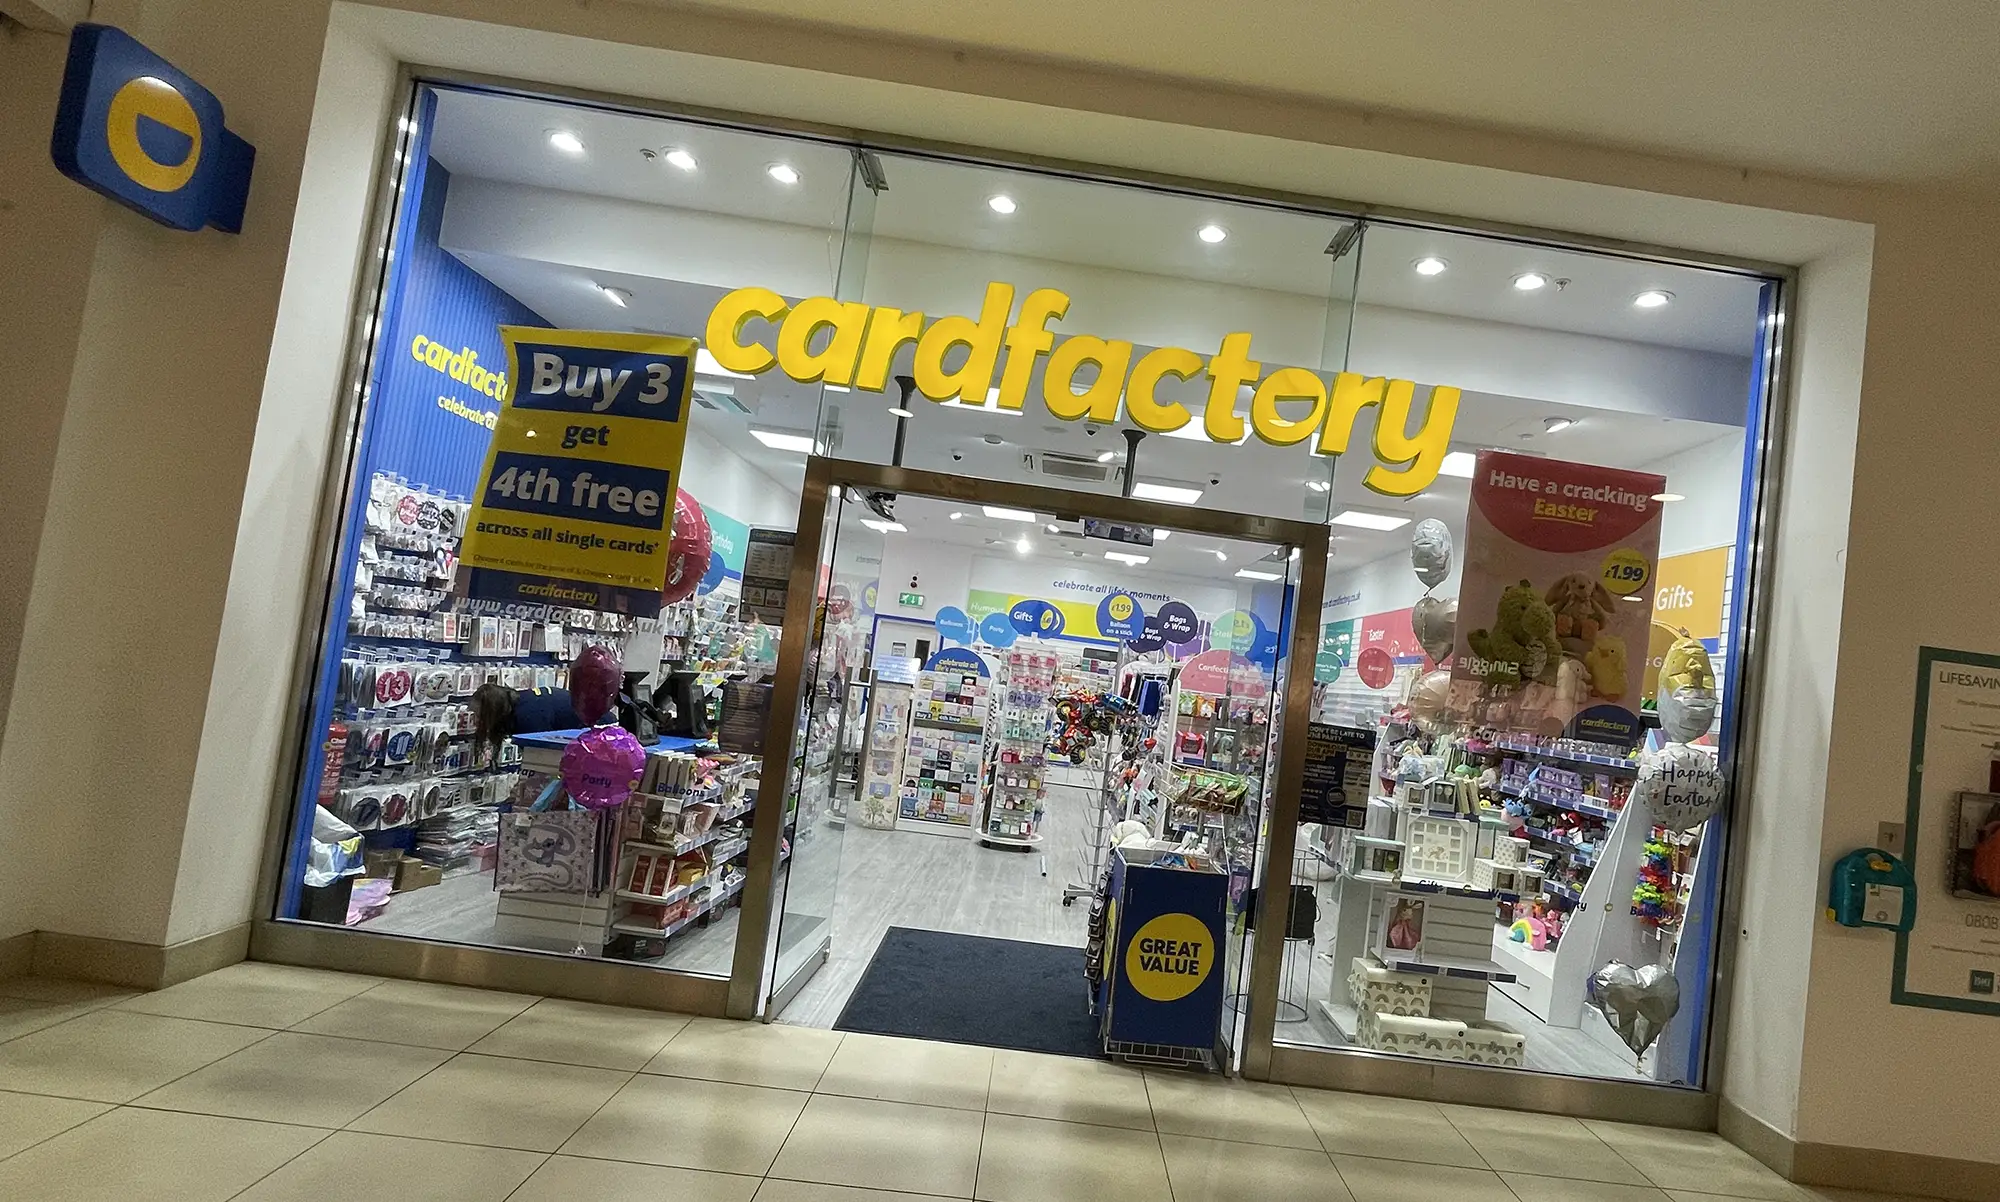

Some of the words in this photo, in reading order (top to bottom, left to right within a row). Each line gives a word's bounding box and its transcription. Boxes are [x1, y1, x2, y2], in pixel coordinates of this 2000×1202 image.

[412, 334, 509, 402] cardfact
[530, 352, 632, 412] Buy
[638, 363, 673, 404] 3
[705, 282, 1461, 496] cardfactory
[438, 396, 485, 426] celebrate
[561, 424, 610, 449] get
[491, 466, 559, 504] 4th
[572, 471, 661, 517] free
[1489, 469, 1541, 494] Have
[1547, 481, 1559, 495] a
[1563, 483, 1649, 512] cracking
[1533, 498, 1599, 523] Easter
[476, 521, 529, 539] across
[532, 526, 553, 542] all
[556, 530, 605, 551] single
[1604, 563, 1644, 582] £1.99
[518, 582, 599, 606] cardfactory
[1053, 579, 1095, 593] celebrate
[1095, 582, 1107, 594] all
[1129, 590, 1171, 602] moments
[1656, 584, 1694, 611] Gifts
[1013, 611, 1034, 623] Gifts
[1109, 621, 1131, 630] Balloon
[1169, 615, 1188, 625] Bags
[1171, 622, 1191, 634] Wrap
[1144, 627, 1160, 636] Bags
[1146, 632, 1163, 642] Wrap
[1581, 718, 1631, 733] cardfactory
[581, 773, 612, 789] Party
[1662, 760, 1715, 787] Happy
[656, 782, 705, 798] Balloons
[1140, 938, 1202, 958] GREAT
[1140, 955, 1200, 976] VALUE
